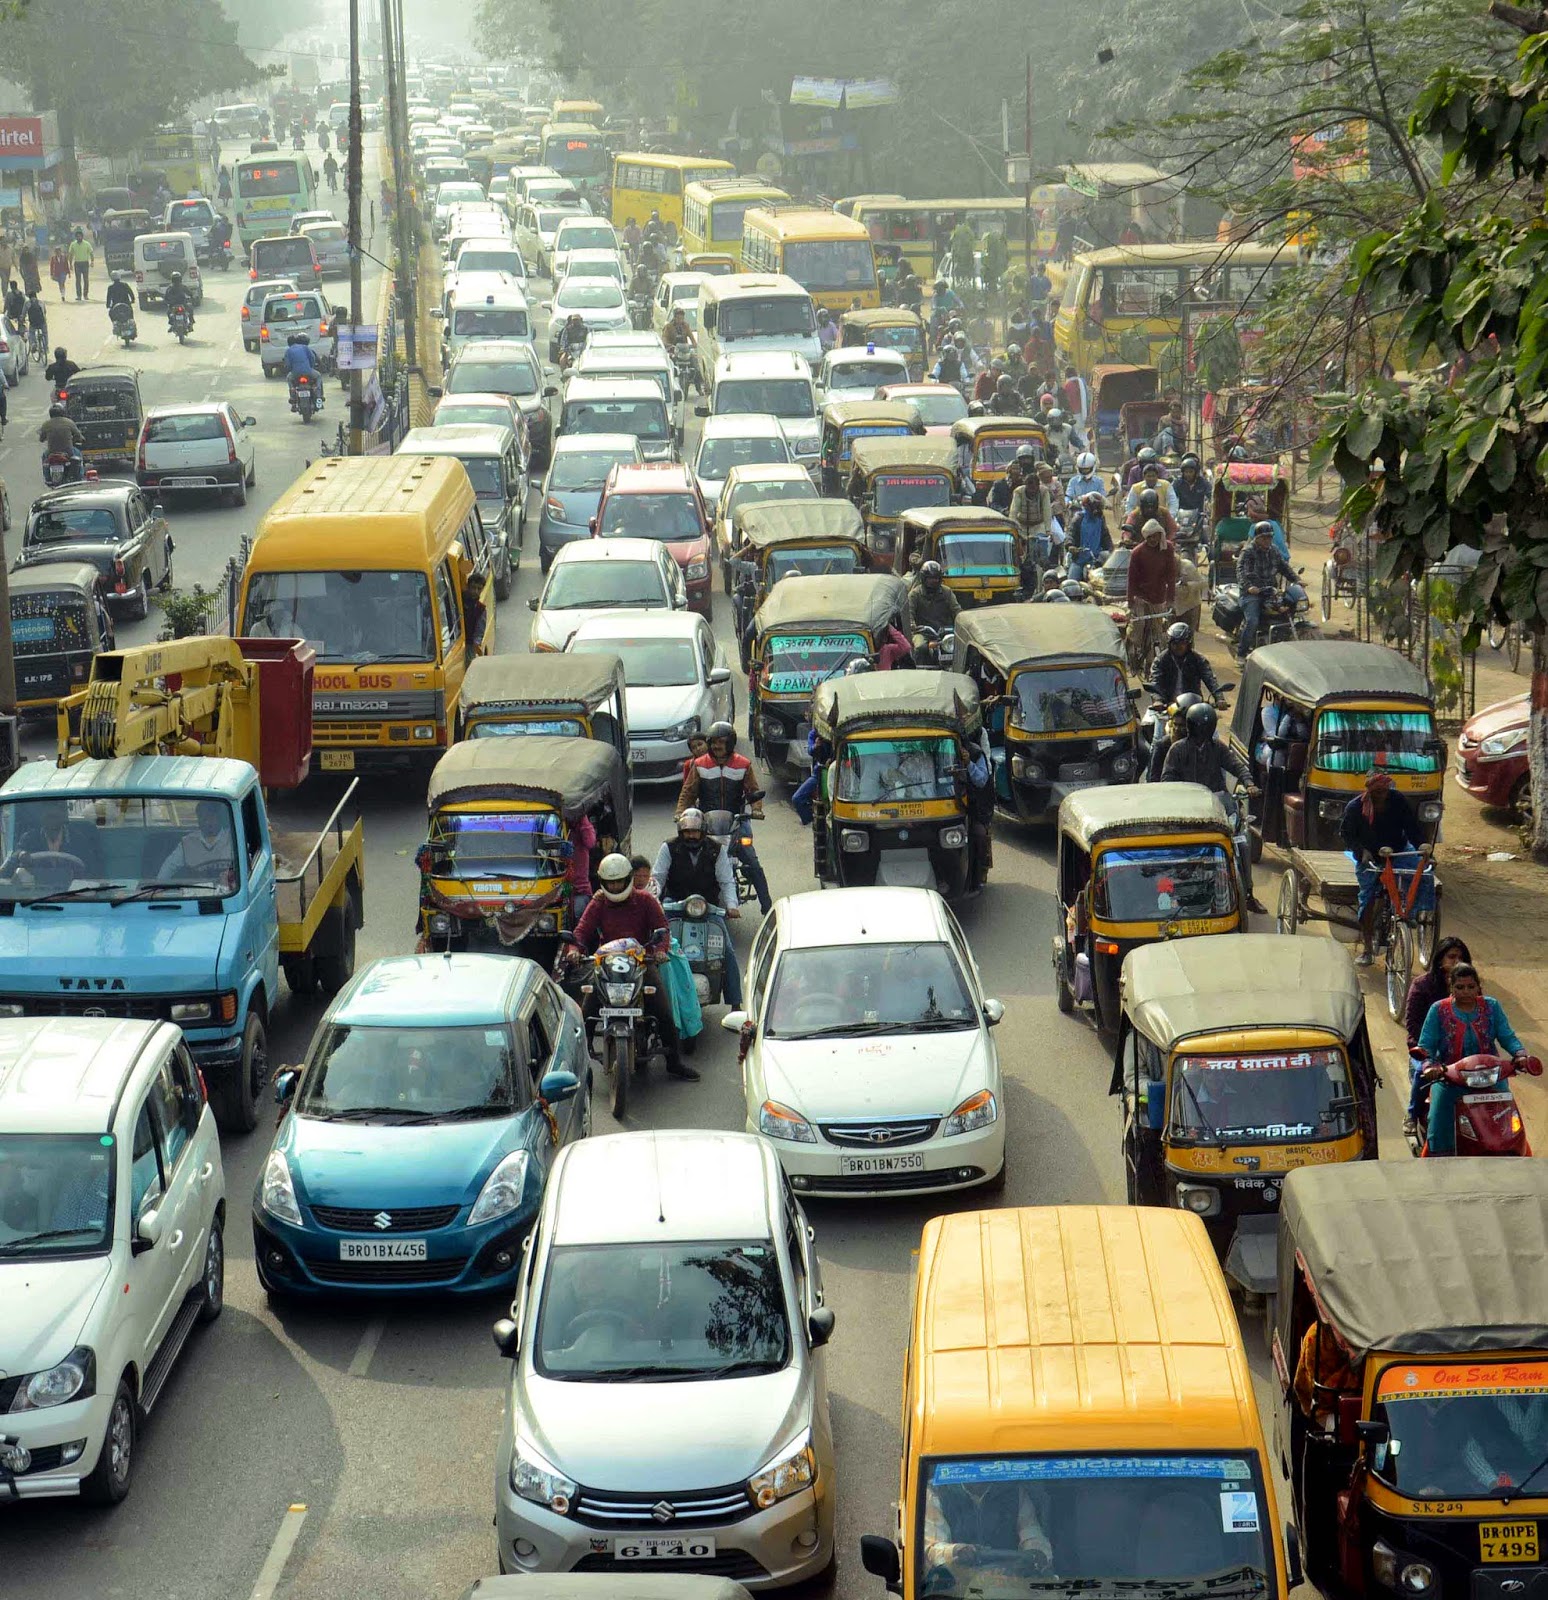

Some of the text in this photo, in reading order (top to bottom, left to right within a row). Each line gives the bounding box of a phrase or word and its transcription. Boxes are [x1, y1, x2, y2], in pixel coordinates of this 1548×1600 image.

[0, 129, 35, 146] irtel
[314, 674, 392, 689] HOOL BUS
[60, 978, 125, 990] TATA
[849, 1155, 922, 1172] BR01BN7550
[1234, 1178, 1265, 1190] विवेक
[348, 1243, 425, 1257] BR01BX4456
[1433, 1366, 1544, 1384] Om Sai Ram
[620, 1545, 709, 1558] 6140
[1483, 1542, 1536, 1558] 7498
